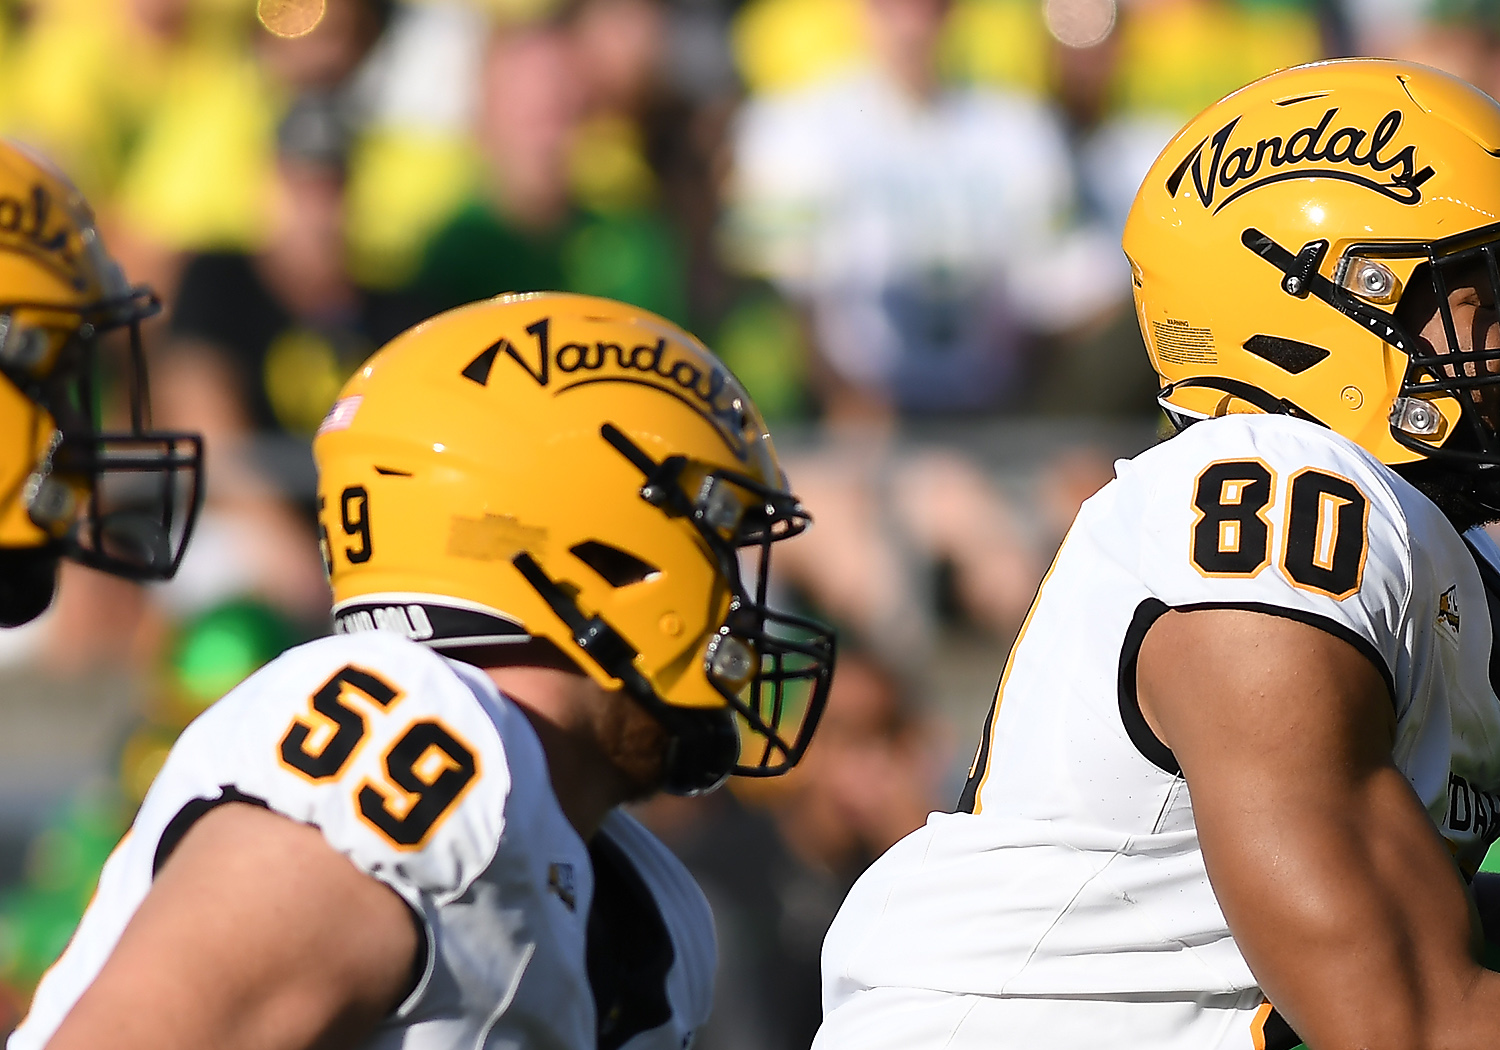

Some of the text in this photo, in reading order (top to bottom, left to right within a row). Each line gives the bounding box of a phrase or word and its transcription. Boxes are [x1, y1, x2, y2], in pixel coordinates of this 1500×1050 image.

[1166, 108, 1436, 212] Vandals
[1190, 457, 1370, 602] 80
[276, 663, 481, 852] 59
